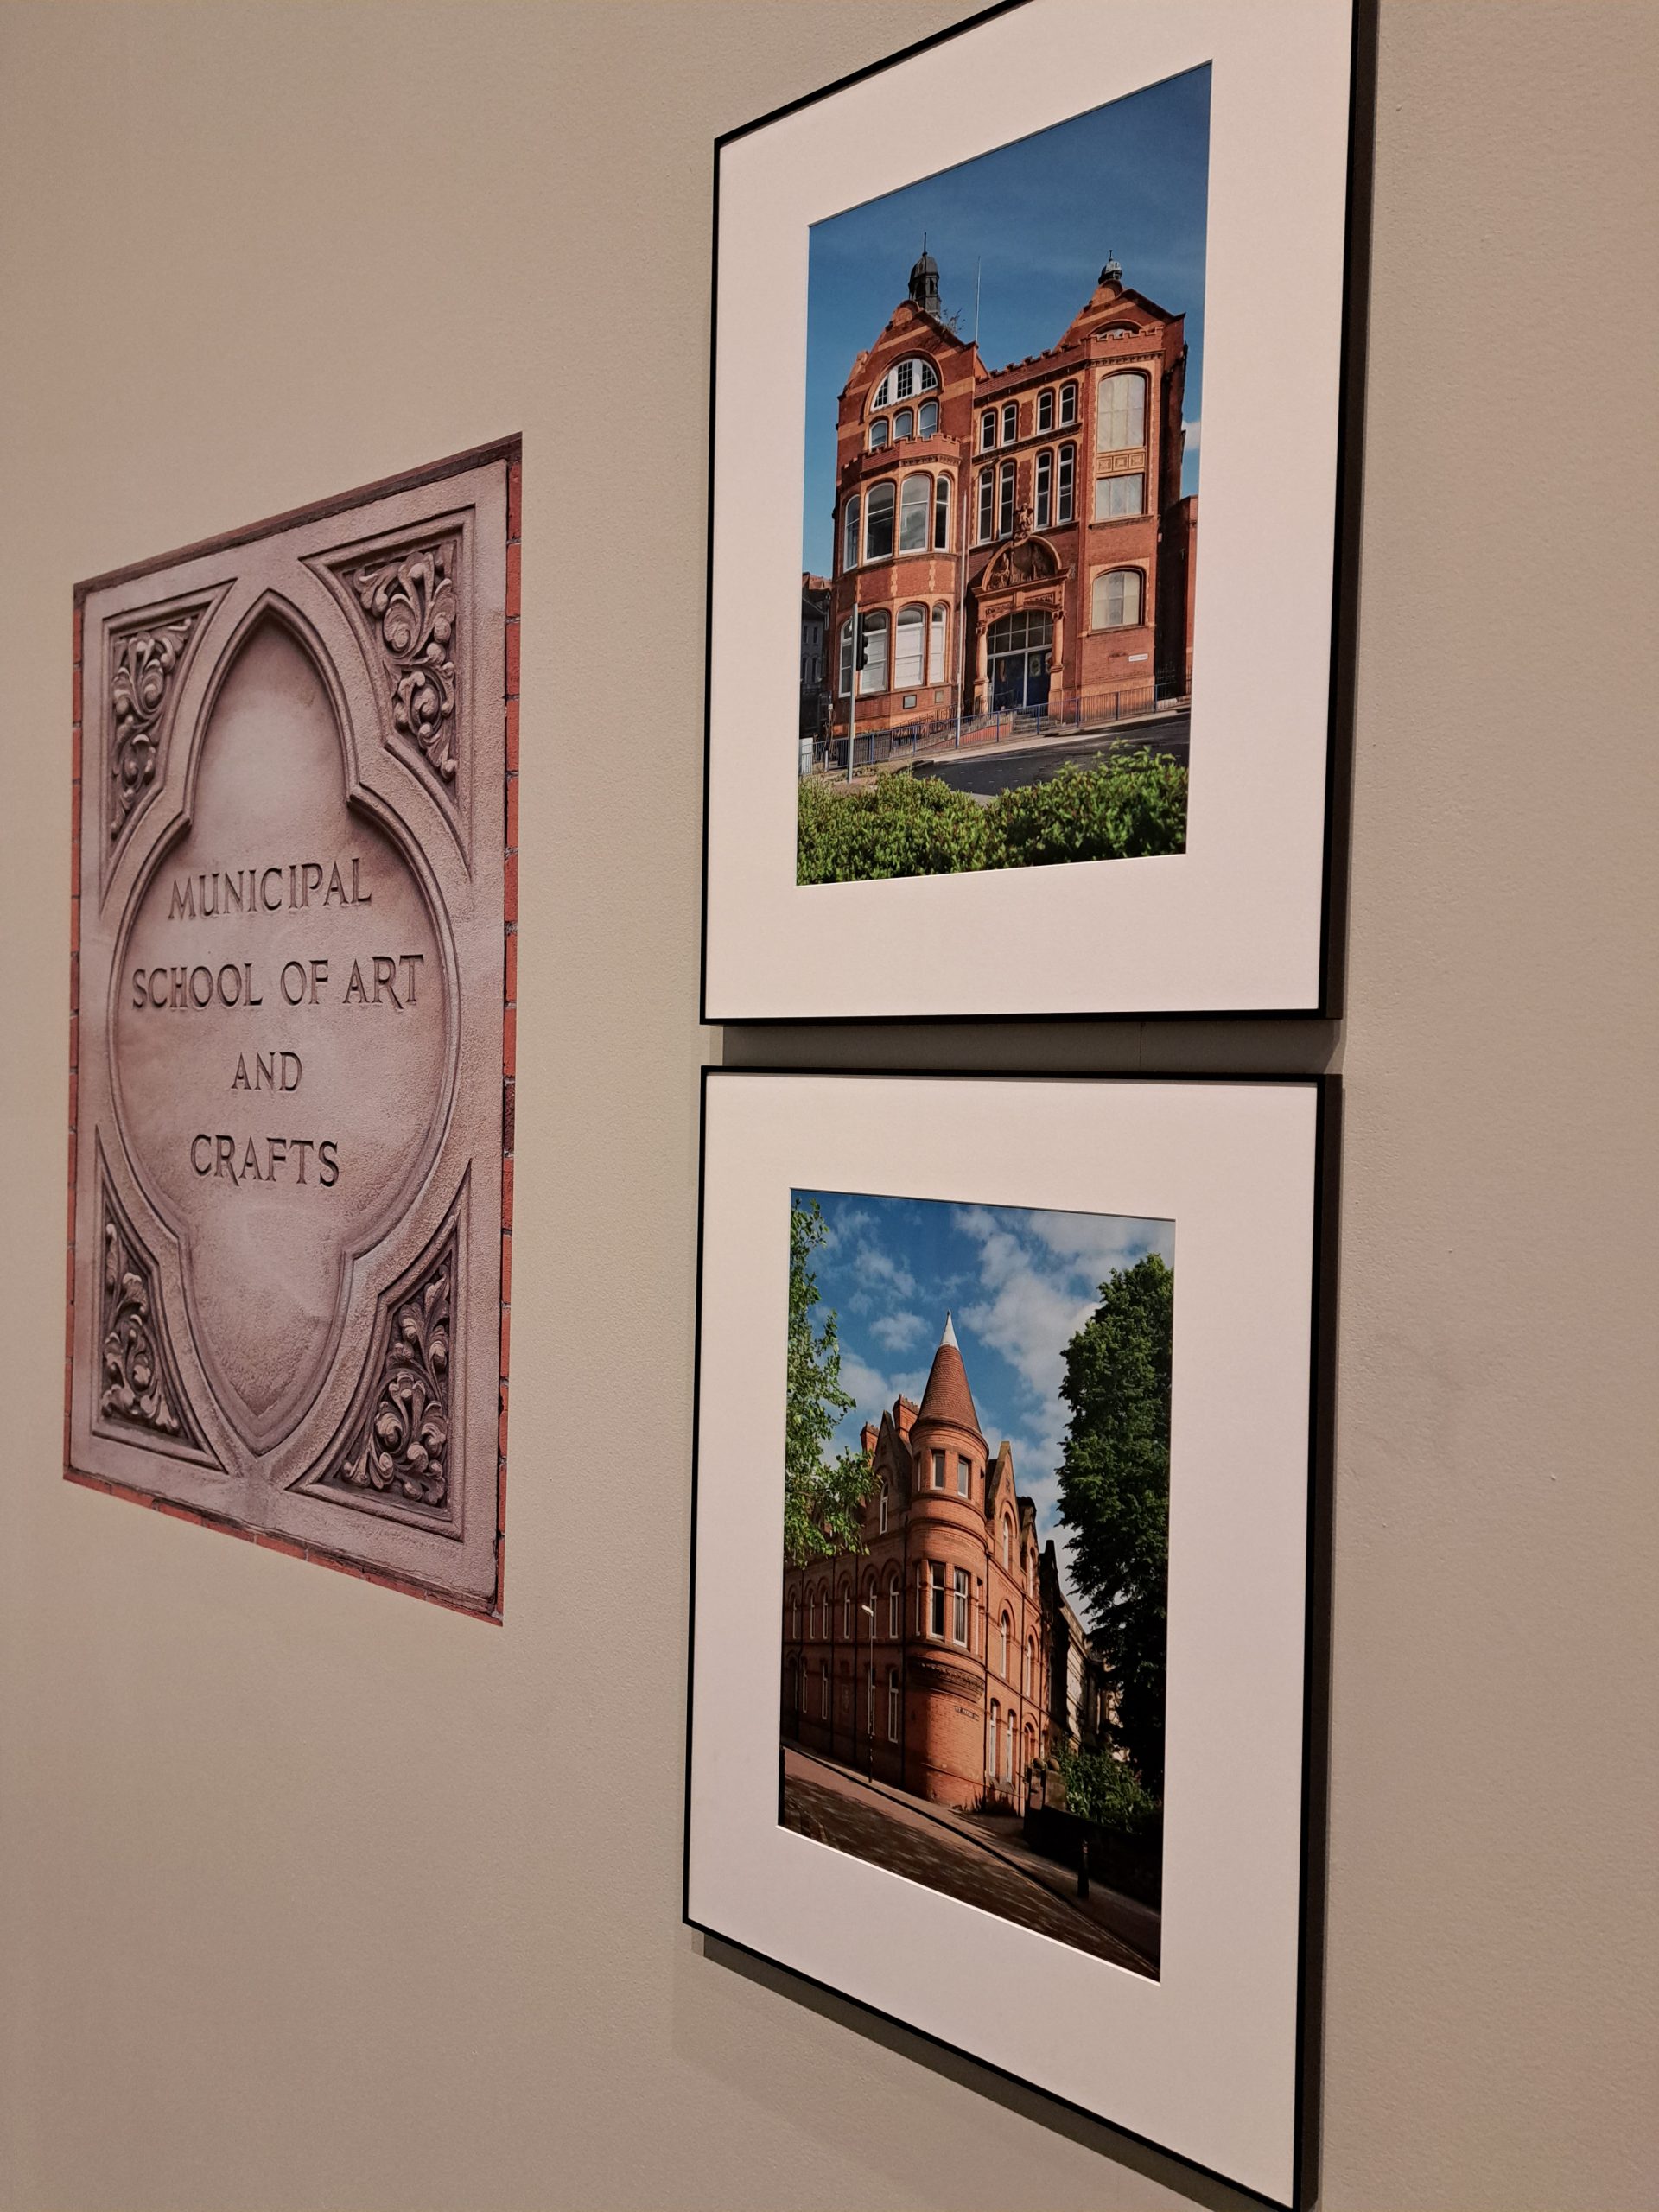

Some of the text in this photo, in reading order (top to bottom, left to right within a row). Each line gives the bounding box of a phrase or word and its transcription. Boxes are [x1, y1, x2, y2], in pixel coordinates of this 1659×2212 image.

[168, 857, 372, 920] MUNICIPAL
[132, 954, 424, 1009] SCHOOL OF ART
[231, 1051, 303, 1092] AND
[190, 1133, 340, 1187] CRAFTS
